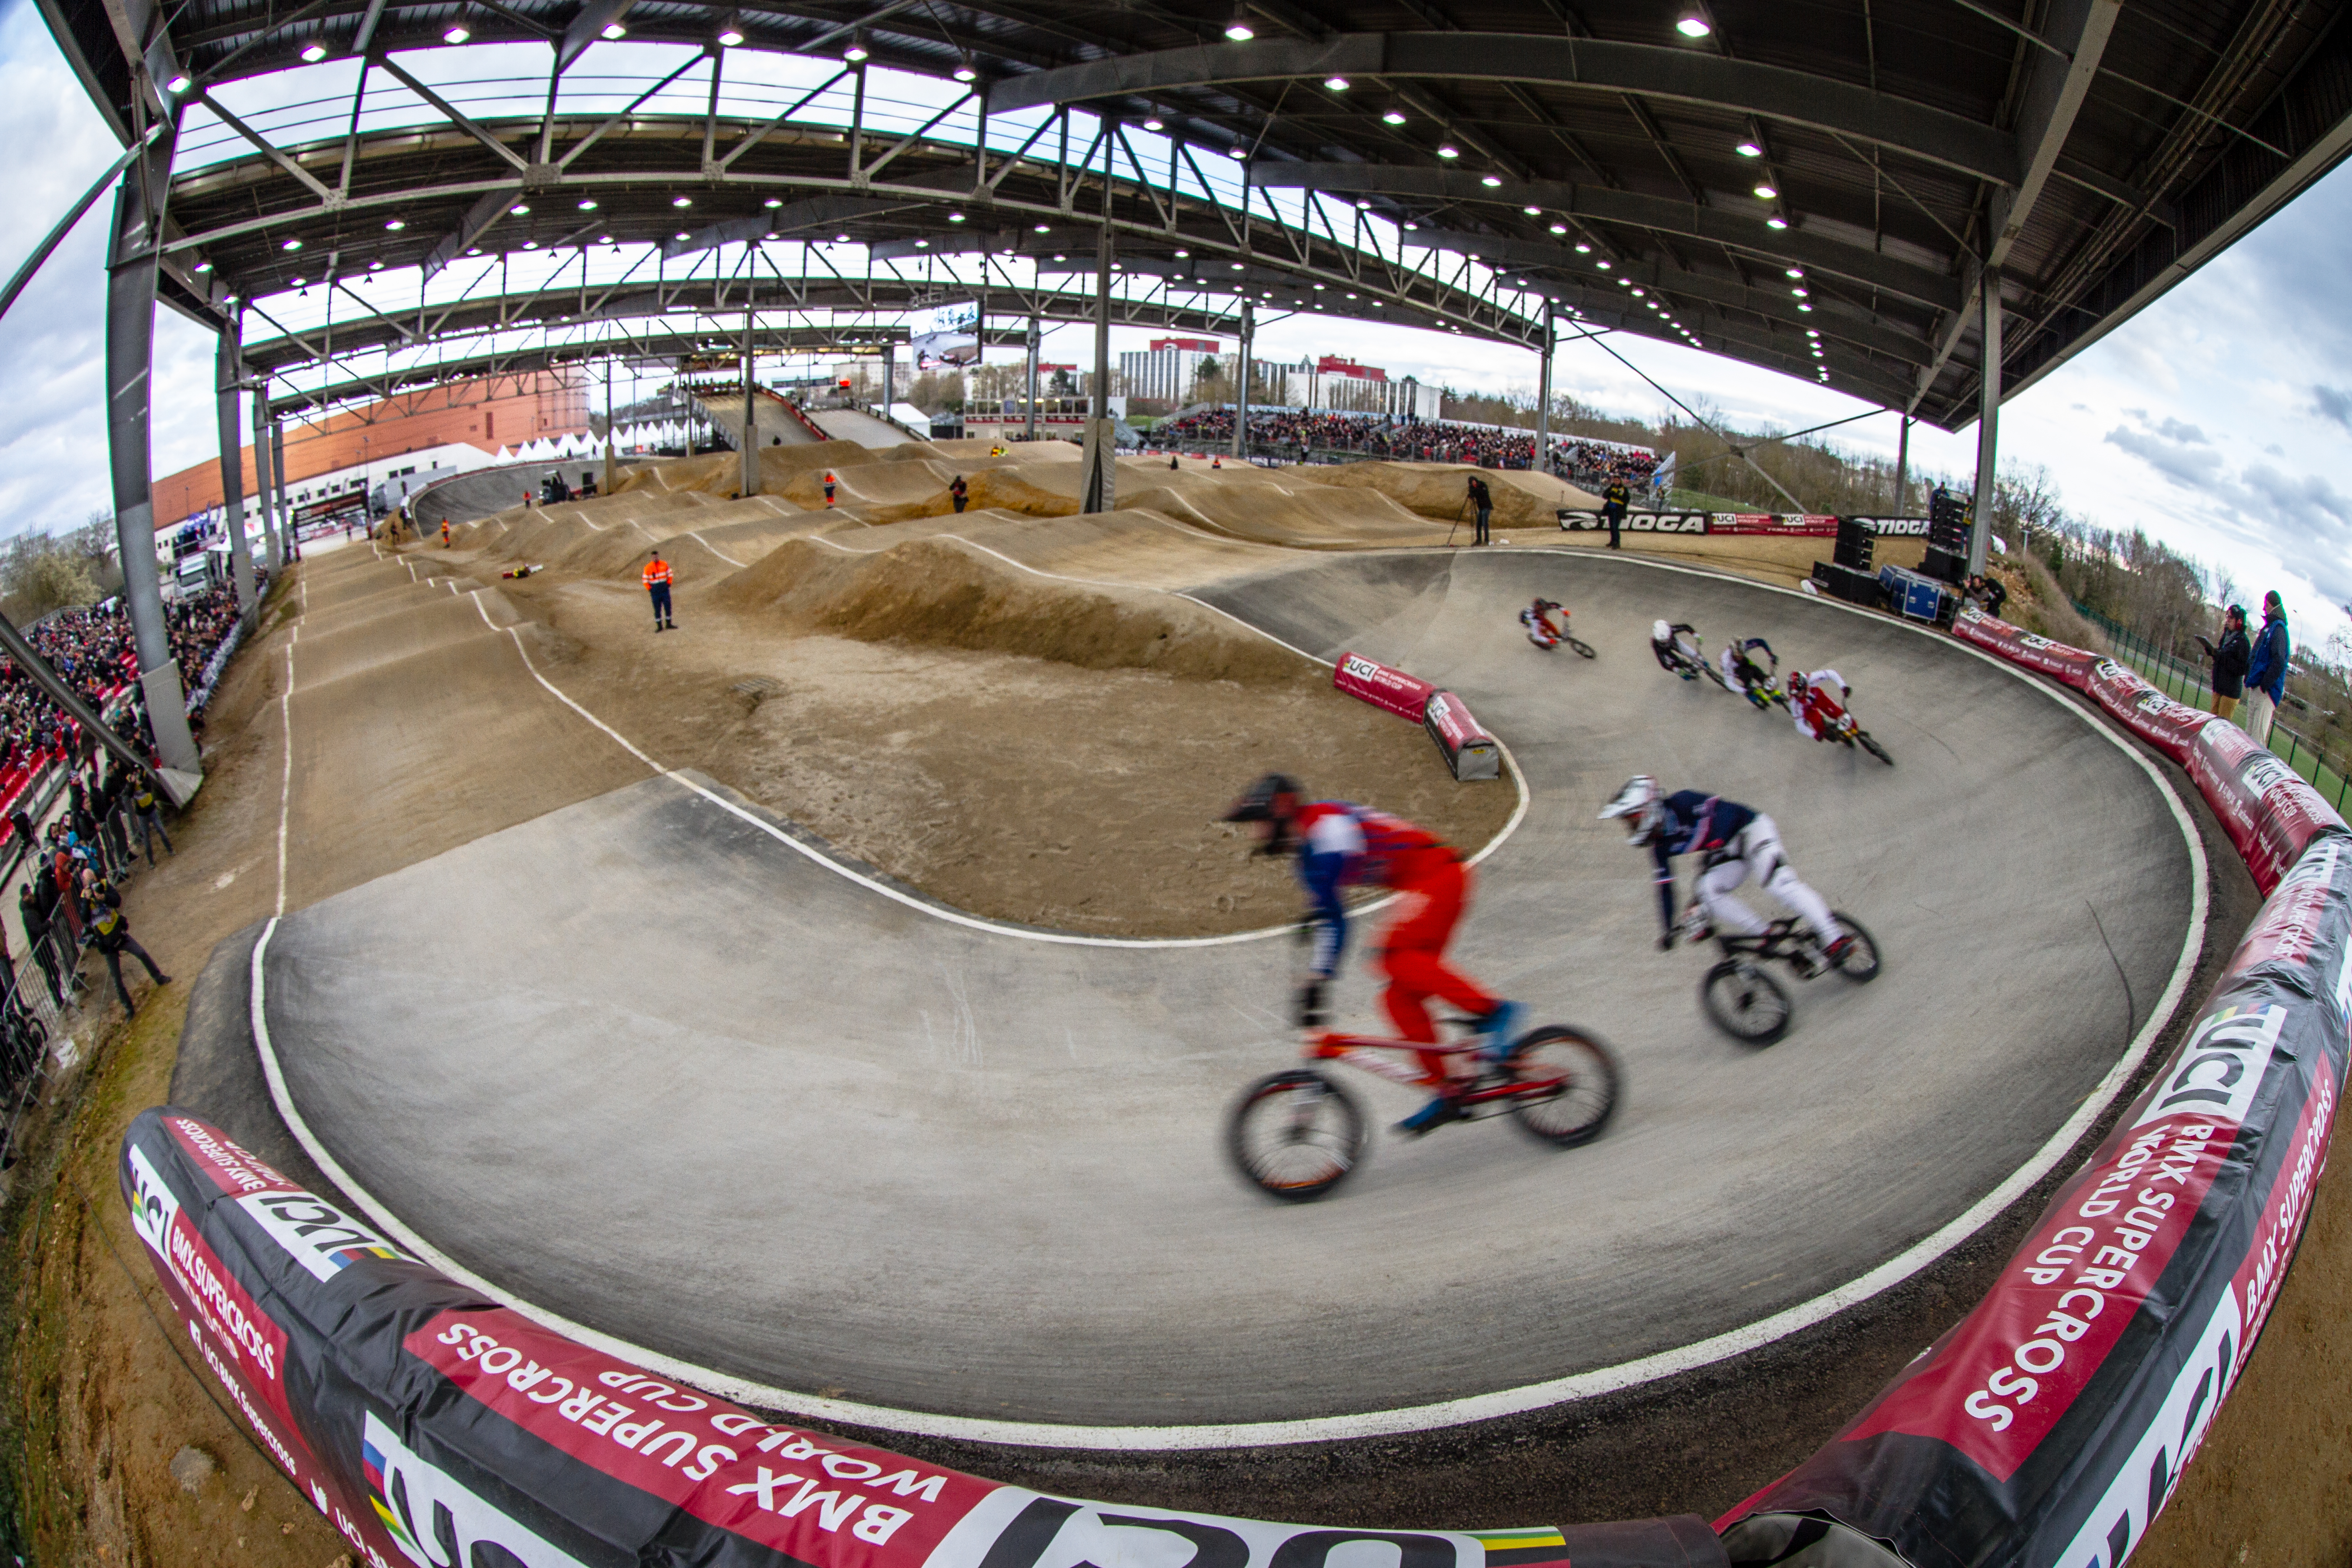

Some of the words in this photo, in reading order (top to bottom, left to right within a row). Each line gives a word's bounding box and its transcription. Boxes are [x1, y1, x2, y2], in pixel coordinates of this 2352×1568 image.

[1716, 514, 1734, 522] UCI
[1876, 519, 1931, 535] TIOGA
[1349, 660, 1375, 677] UCI
[2029, 637, 2050, 647] UCI
[2252, 763, 2285, 790] UCI
[2282, 802, 2298, 819] CUP
[2285, 849, 2329, 887] UCI
[2158, 1018, 2265, 1112] UCI
[176, 1119, 240, 1167] SUPERCROSS
[2079, 1124, 2171, 1218] WORLD
[2150, 1125, 2215, 1186] BMX
[224, 1167, 267, 1191] BMX
[2246, 1222, 2277, 1328] BMX
[2279, 1078, 2331, 1245] SUPERCROSS
[258, 1196, 377, 1253] UCI
[2023, 1226, 2095, 1285] CUP
[172, 1226, 196, 1279] BMX
[192, 1256, 274, 1380] SUPERCROSS
[1965, 1187, 2175, 1432] SUPERCROSS
[204, 1342, 220, 1376] UCI
[219, 1362, 241, 1405] BMX
[240, 1391, 296, 1476] Supercross
[437, 1323, 738, 1481] SUPERCROSS
[598, 1371, 708, 1412] CUP
[710, 1413, 948, 1503] WORLD
[725, 1465, 914, 1546] BMX
